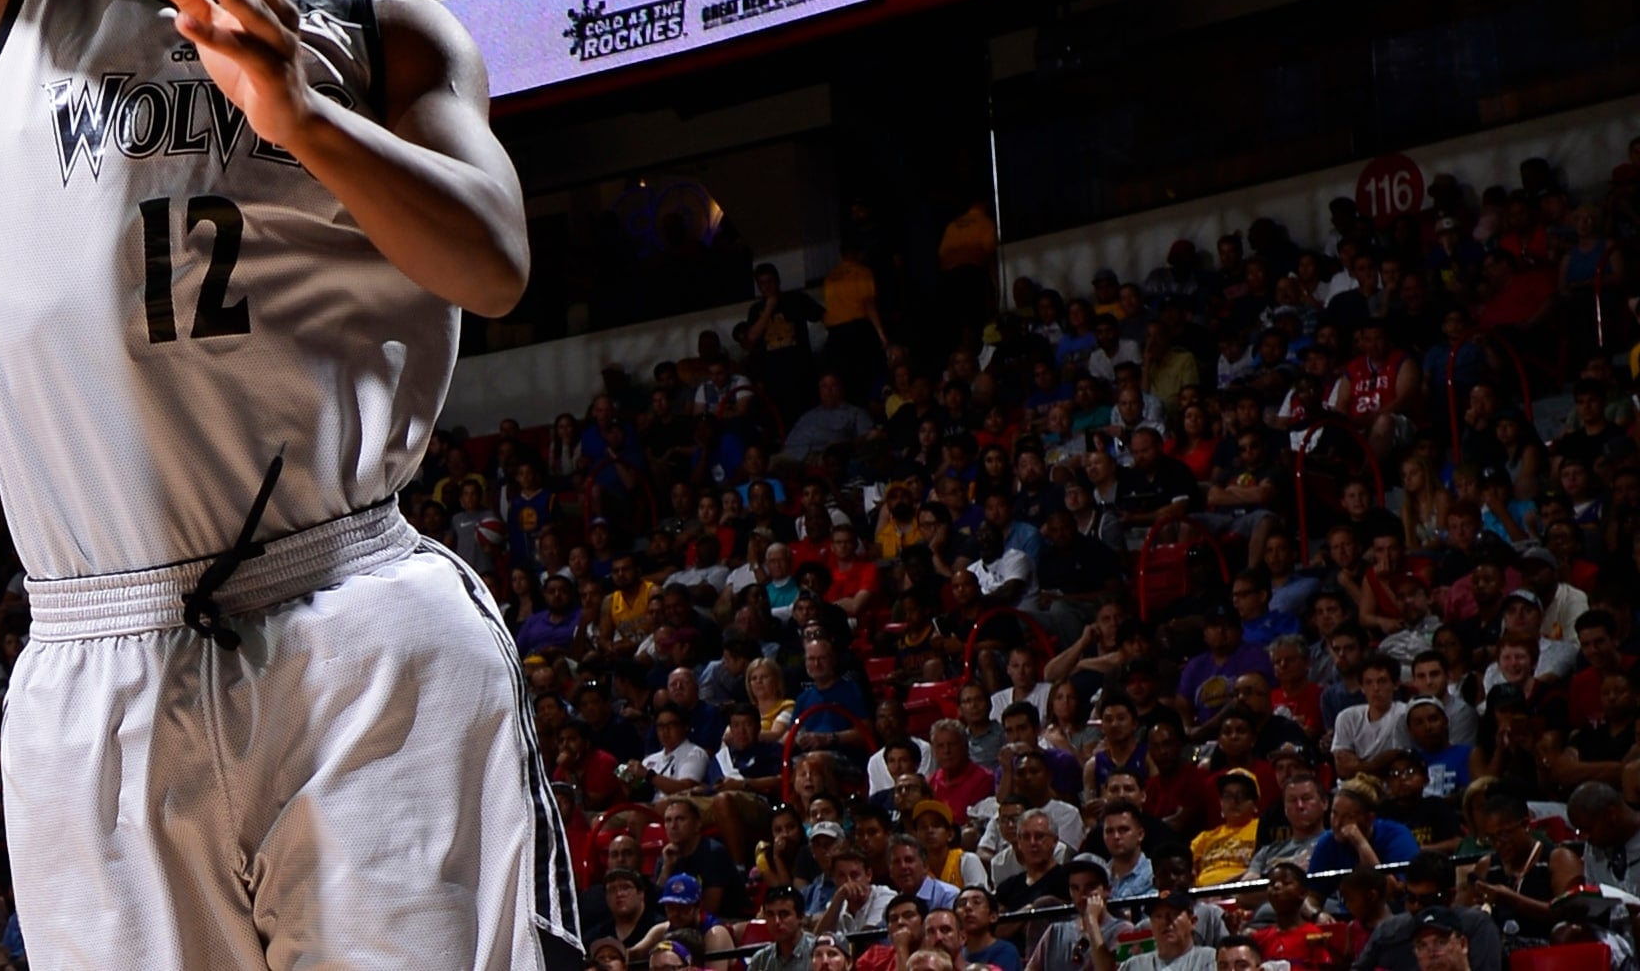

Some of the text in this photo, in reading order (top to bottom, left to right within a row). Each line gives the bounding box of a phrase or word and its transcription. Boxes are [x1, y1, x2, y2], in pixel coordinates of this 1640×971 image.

[583, 17, 682, 59] ROCKIES
[585, 15, 624, 37] COLD
[628, 9, 648, 25] AS
[653, 0, 683, 19] THE
[43, 73, 356, 189] WOLV
[1363, 169, 1414, 219] 116
[139, 194, 251, 344] 12
